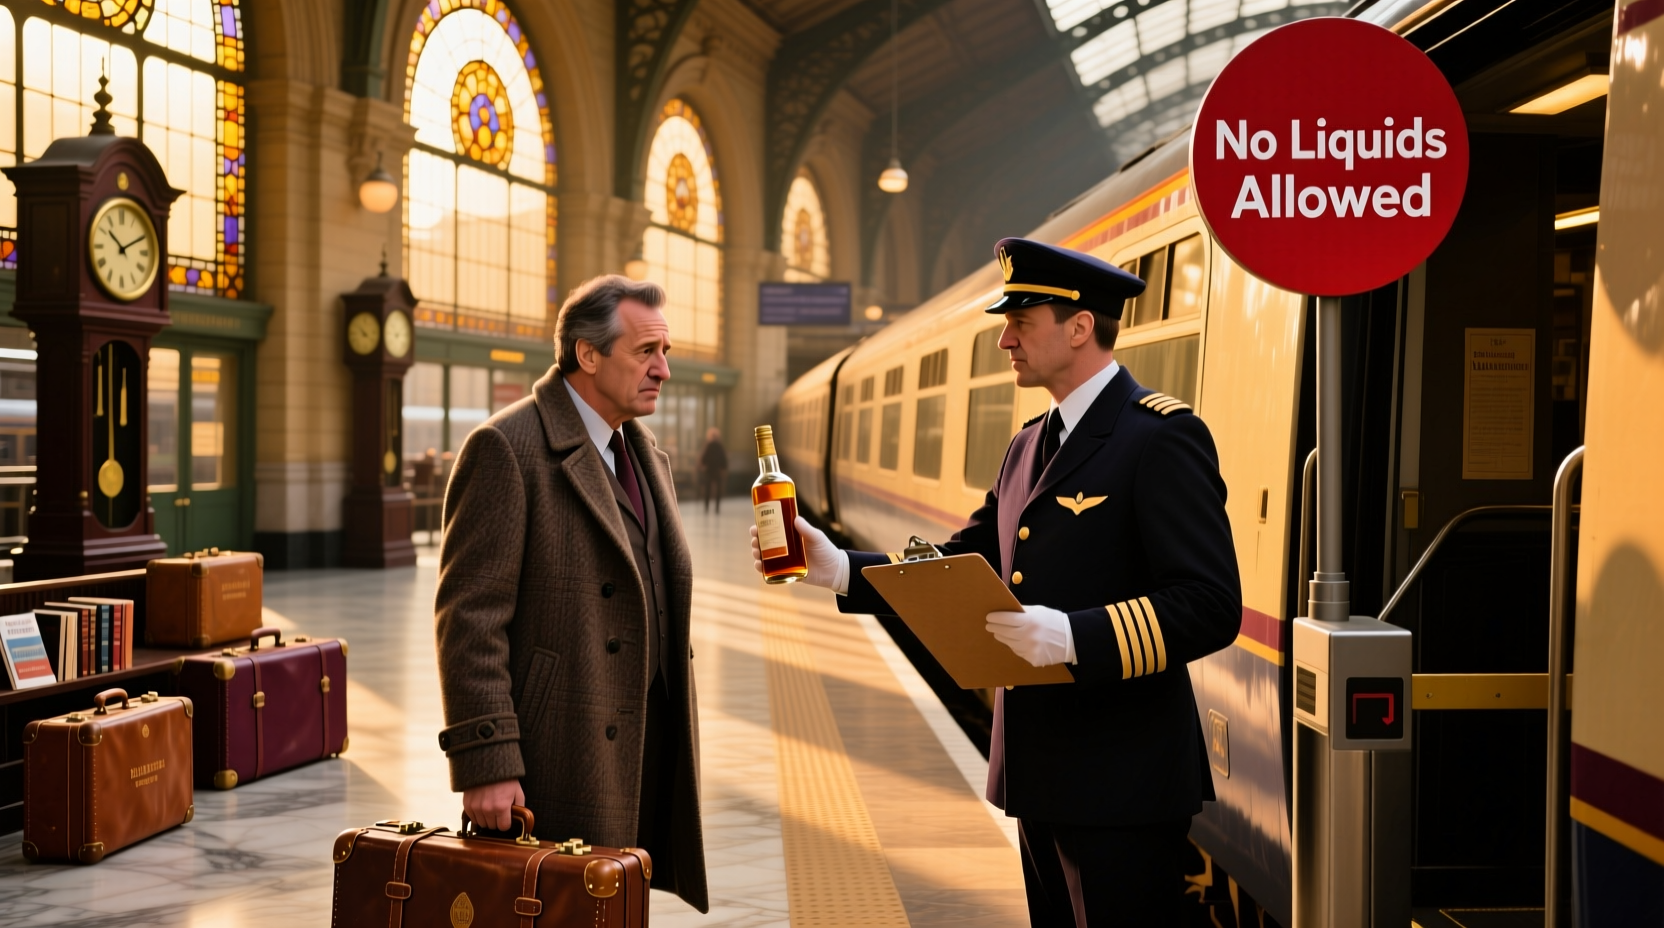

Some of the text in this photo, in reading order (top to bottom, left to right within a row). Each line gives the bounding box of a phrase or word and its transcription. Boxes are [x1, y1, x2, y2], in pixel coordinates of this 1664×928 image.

[1216, 117, 1447, 170] No Liquids
[1231, 173, 1431, 219] Allowed
